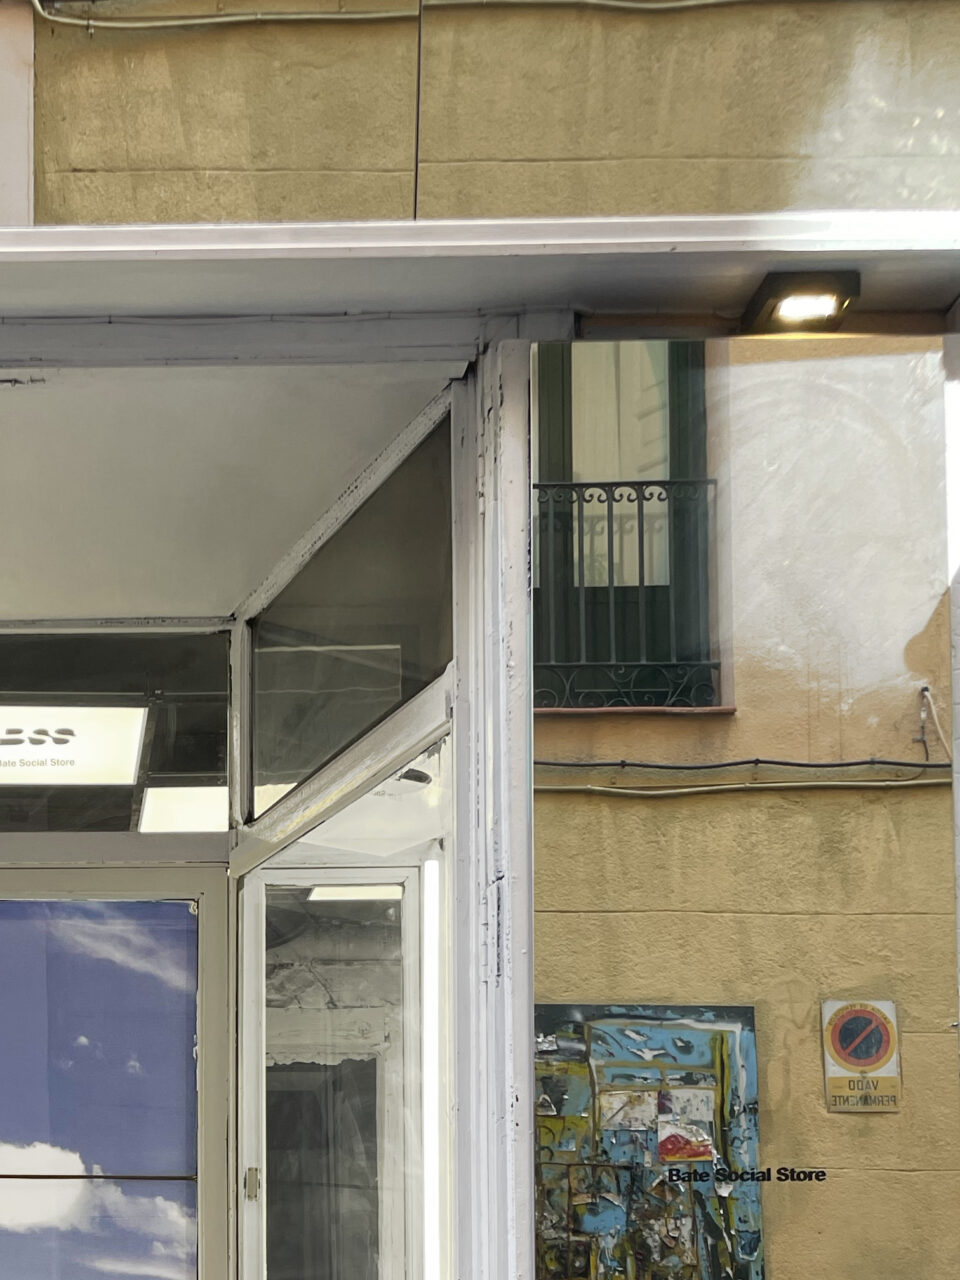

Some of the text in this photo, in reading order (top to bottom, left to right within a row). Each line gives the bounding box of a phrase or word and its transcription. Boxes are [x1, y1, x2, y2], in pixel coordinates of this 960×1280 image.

[19, 758, 48, 767] Social
[50, 758, 75, 767] Store
[668, 1167, 827, 1182] Bate Social Store
